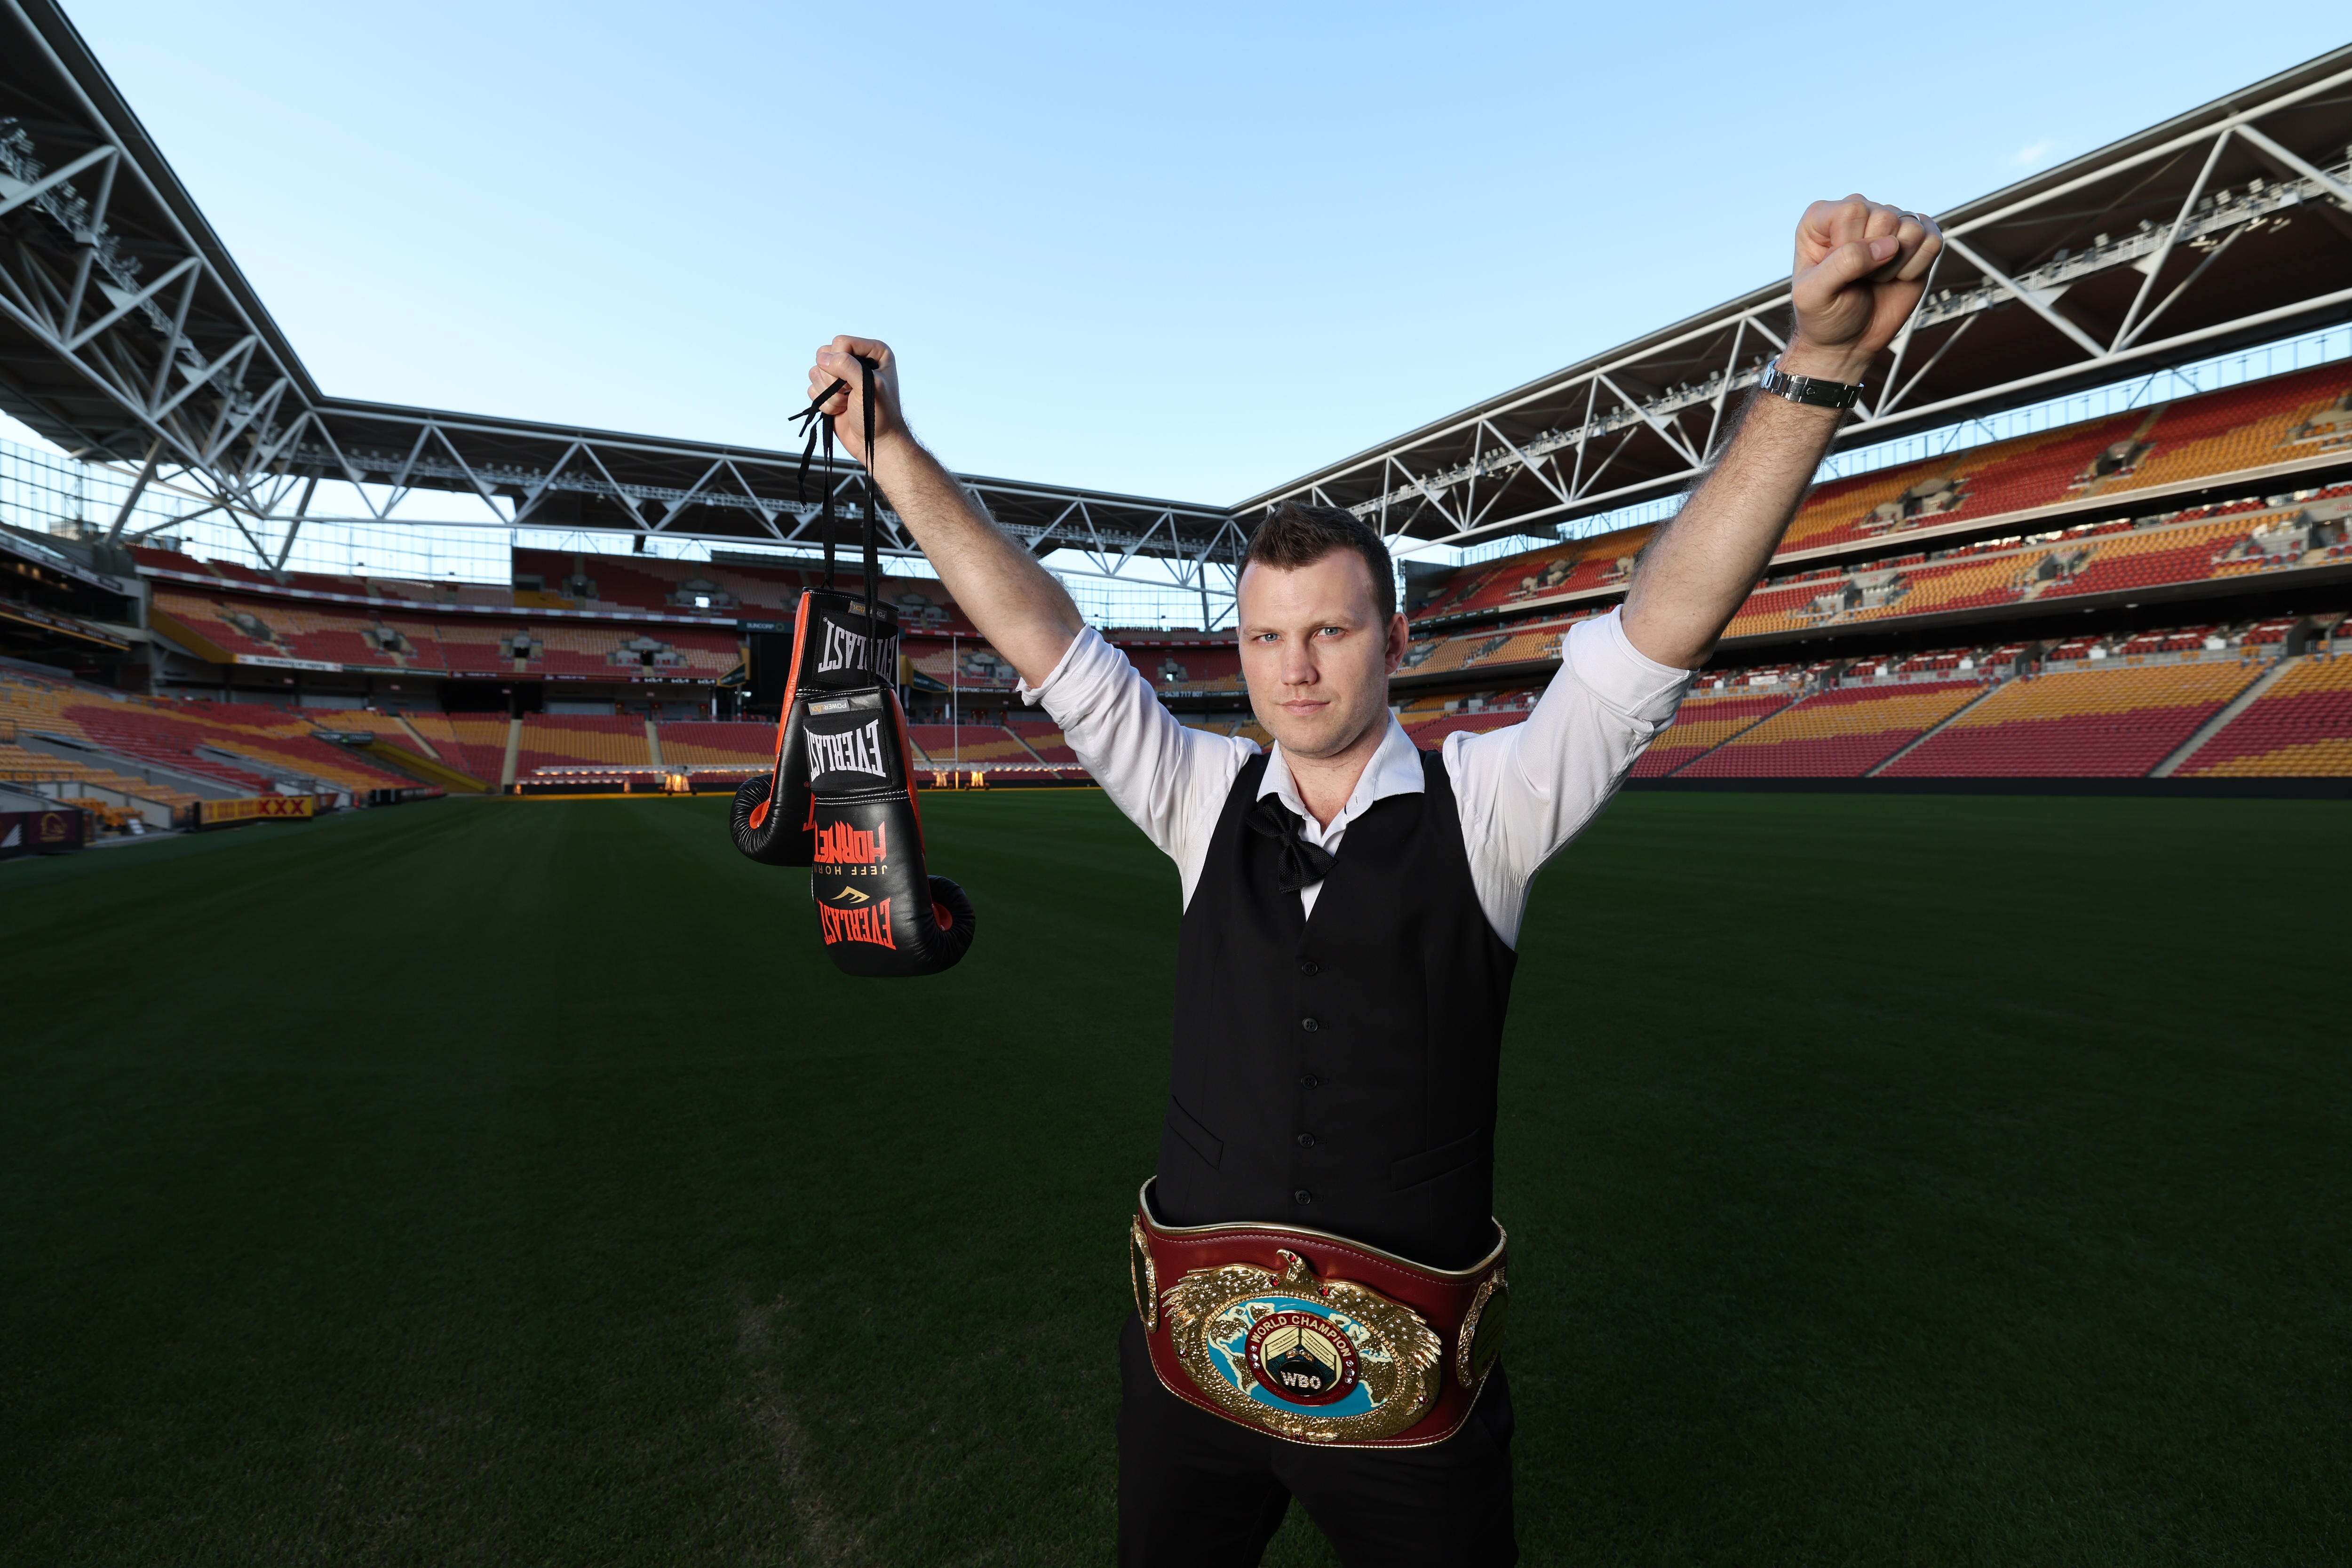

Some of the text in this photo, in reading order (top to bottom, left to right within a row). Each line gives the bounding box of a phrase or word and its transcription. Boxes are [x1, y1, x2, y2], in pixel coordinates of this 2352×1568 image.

[818, 620, 897, 683] EVLAST
[804, 718, 887, 783] EVERLAST
[813, 820, 887, 864] HORNET
[813, 864, 888, 876] JEFF HORN
[818, 898, 897, 951] EVERLAST
[1250, 1315, 1352, 1358] WORLD CHAMPION
[1306, 1335, 1329, 1356] ORGANIZATION
[1280, 1370, 1322, 1390] WBO
